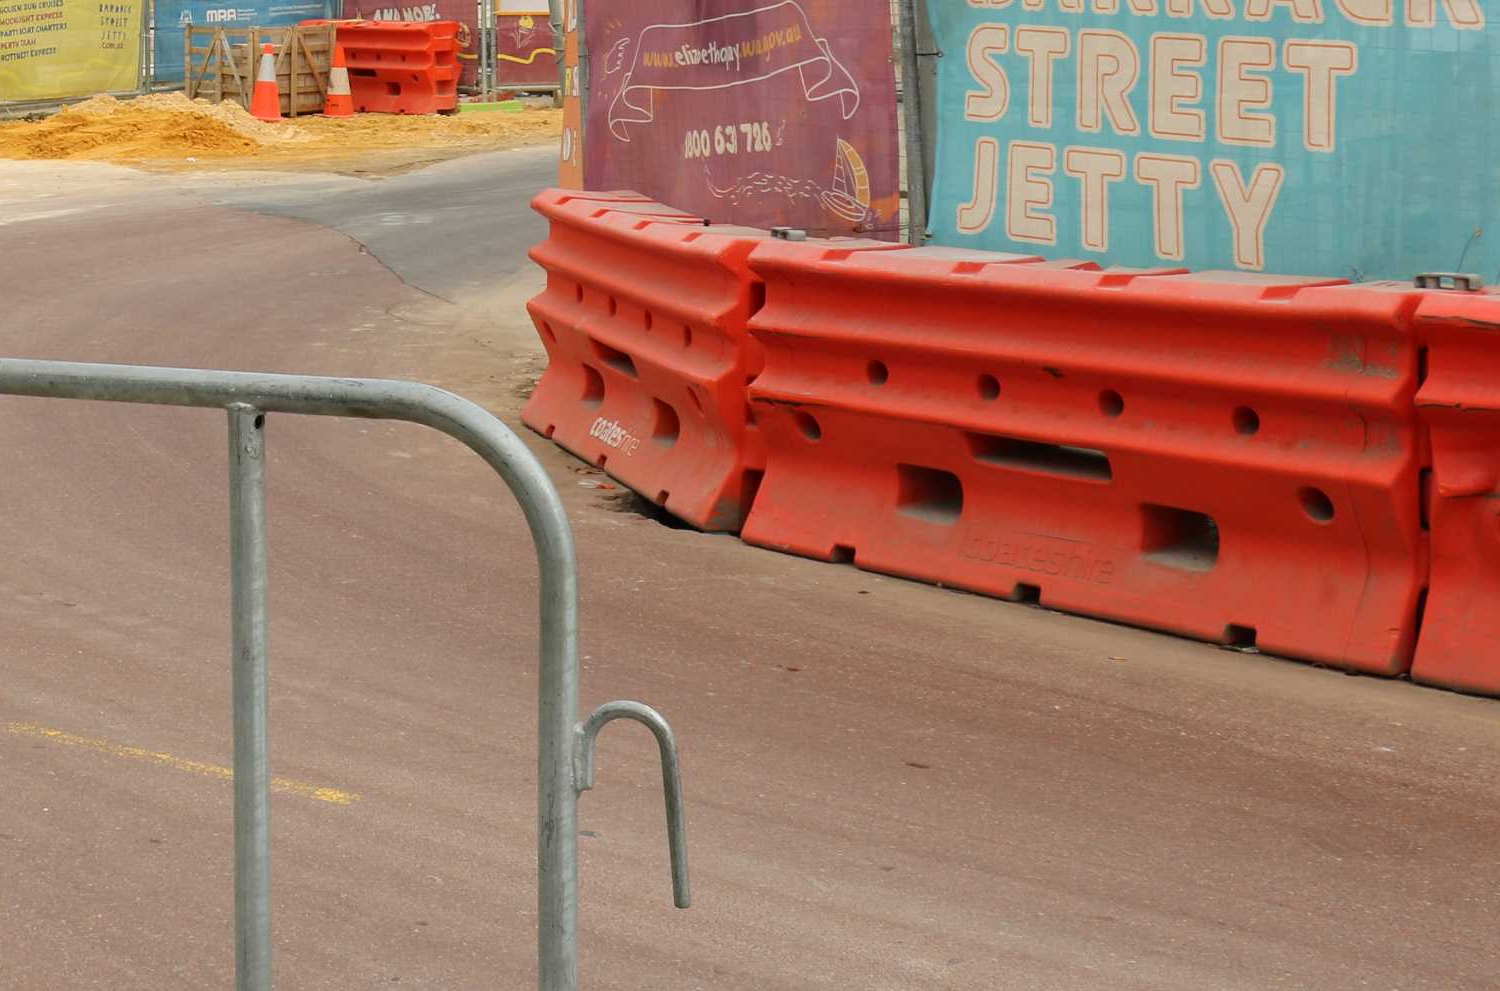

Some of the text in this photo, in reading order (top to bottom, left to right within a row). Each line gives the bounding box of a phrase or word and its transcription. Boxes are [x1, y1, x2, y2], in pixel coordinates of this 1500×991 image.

[740, 121, 772, 152] 726
[964, 22, 1358, 153] STREET
[955, 136, 1284, 272] JETTY
